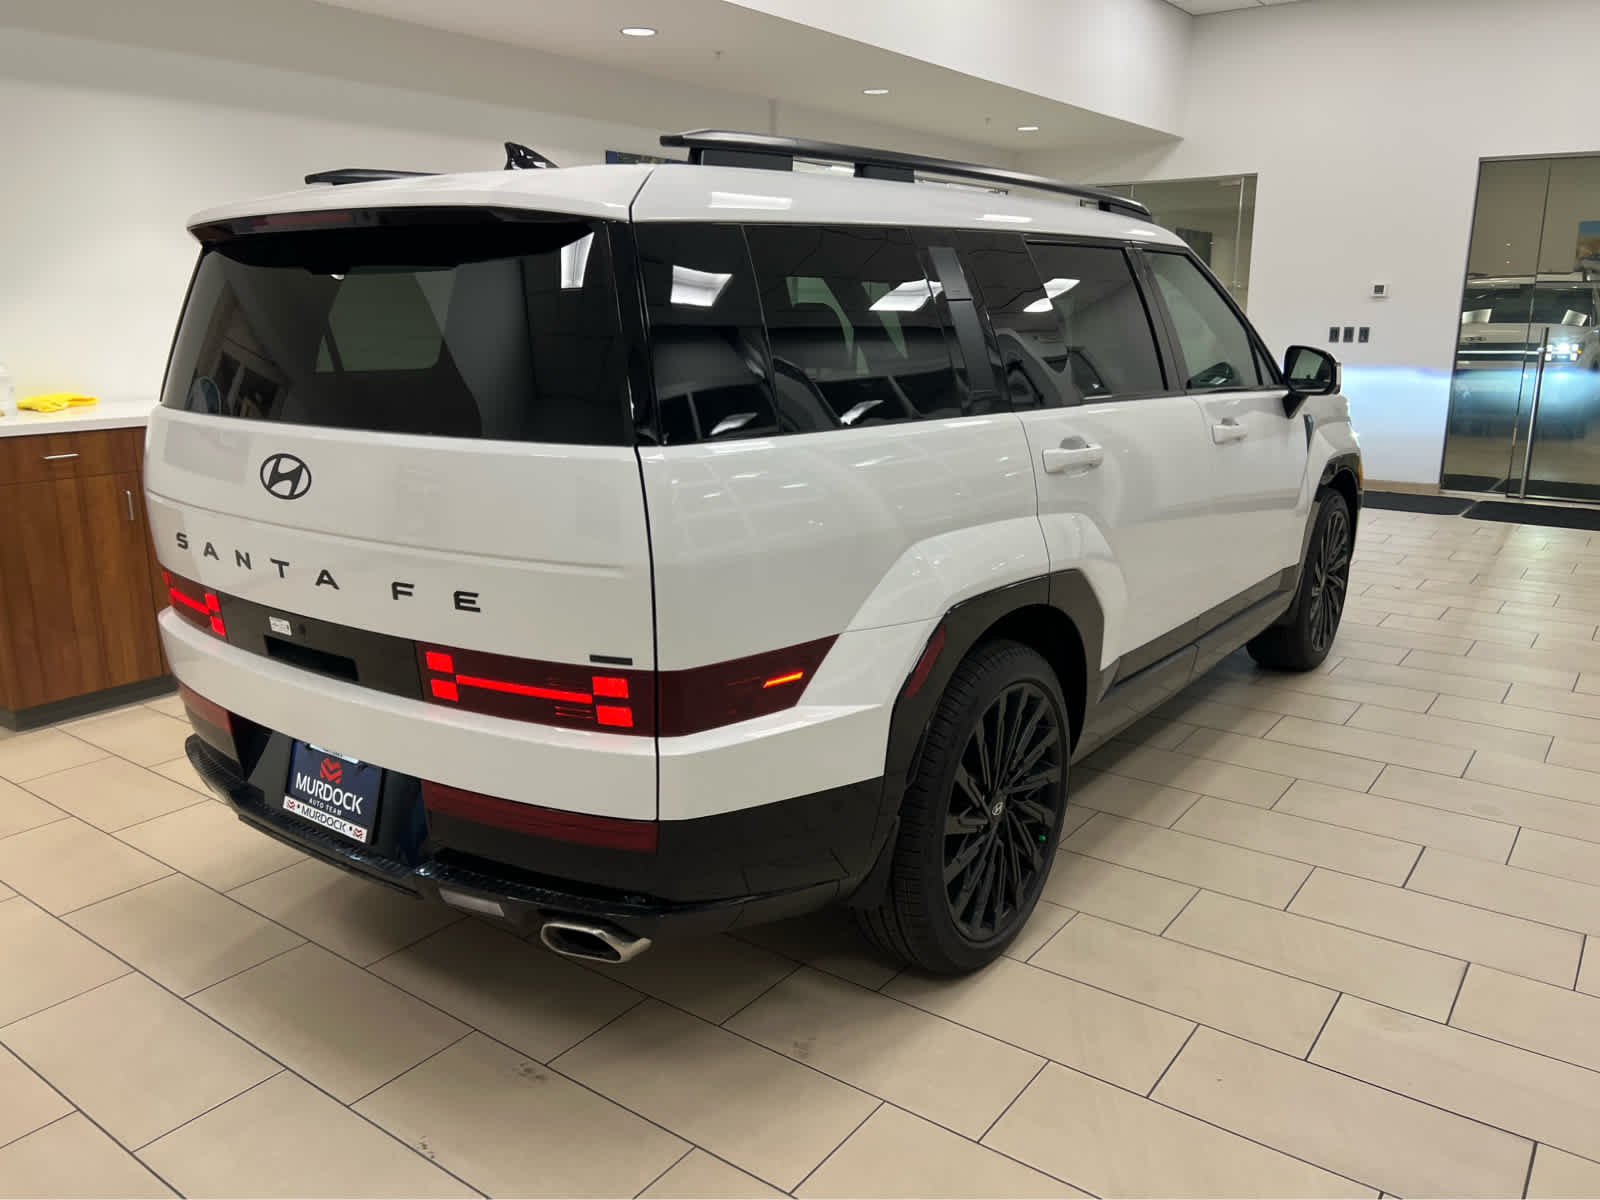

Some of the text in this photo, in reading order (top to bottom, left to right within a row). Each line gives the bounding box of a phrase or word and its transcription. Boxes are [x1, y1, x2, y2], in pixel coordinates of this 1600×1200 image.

[176, 532, 481, 613] SANTA FE
[295, 771, 363, 815] MURDOCK
[309, 798, 342, 816] AUTO TEAM
[301, 805, 347, 832] MURDOCK
